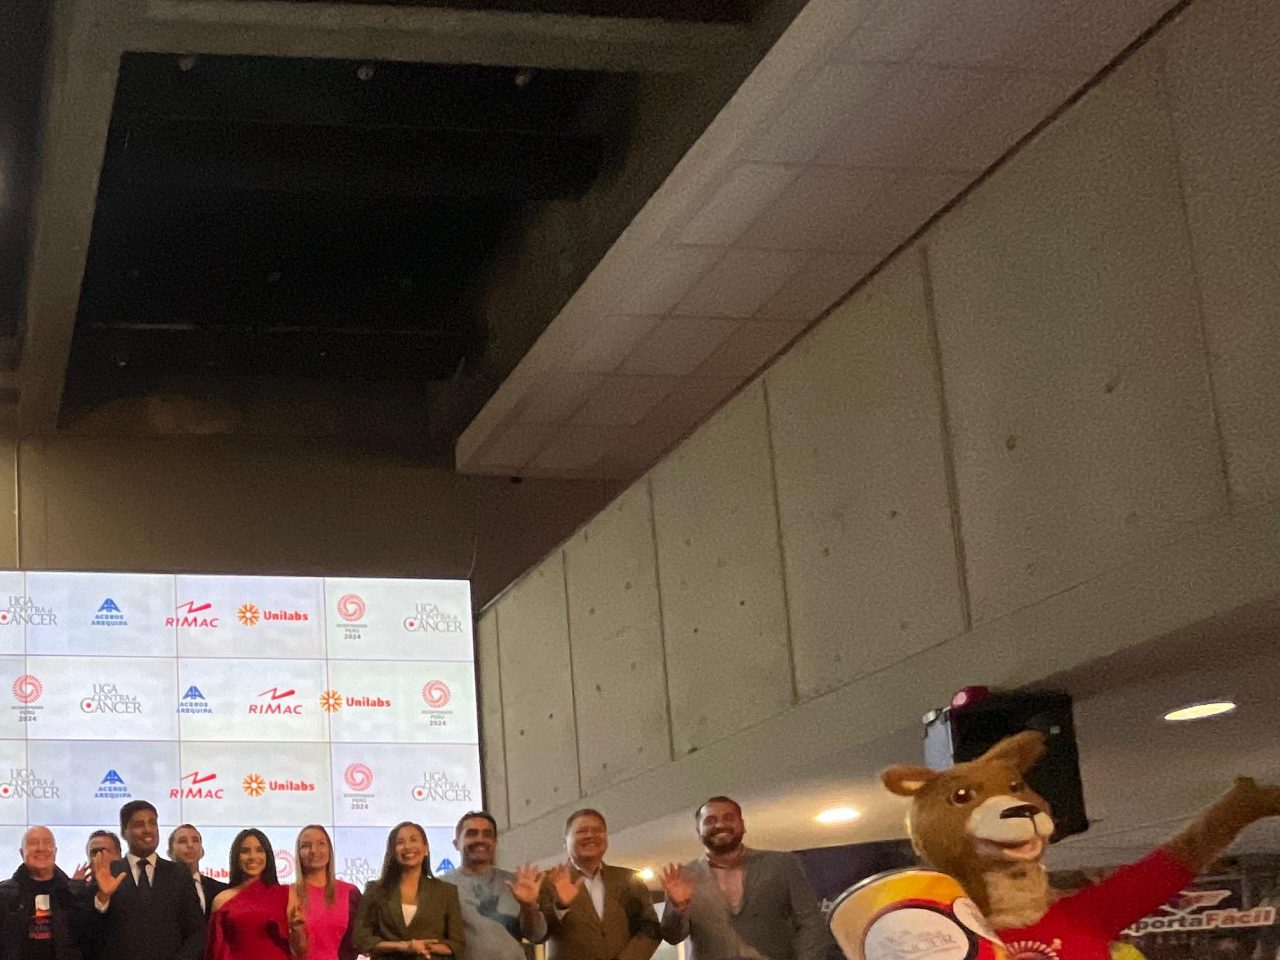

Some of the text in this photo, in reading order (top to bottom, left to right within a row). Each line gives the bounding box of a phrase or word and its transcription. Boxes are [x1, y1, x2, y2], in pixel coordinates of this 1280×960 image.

[8, 596, 33, 606] LIGA
[415, 603, 439, 614] LIGA
[263, 610, 309, 621] Unilabs
[165, 616, 219, 628] RIMAC
[92, 683, 118, 694] LIGA
[346, 697, 391, 708] Unilabs
[248, 703, 303, 715] RIMAC
[10, 768, 36, 779] LIGA
[423, 771, 448, 782] LIGA
[269, 780, 315, 791] Unilabs
[169, 787, 225, 799] RIMAC
[344, 858, 369, 868] LIGA
[343, 869, 381, 878] CONTR
